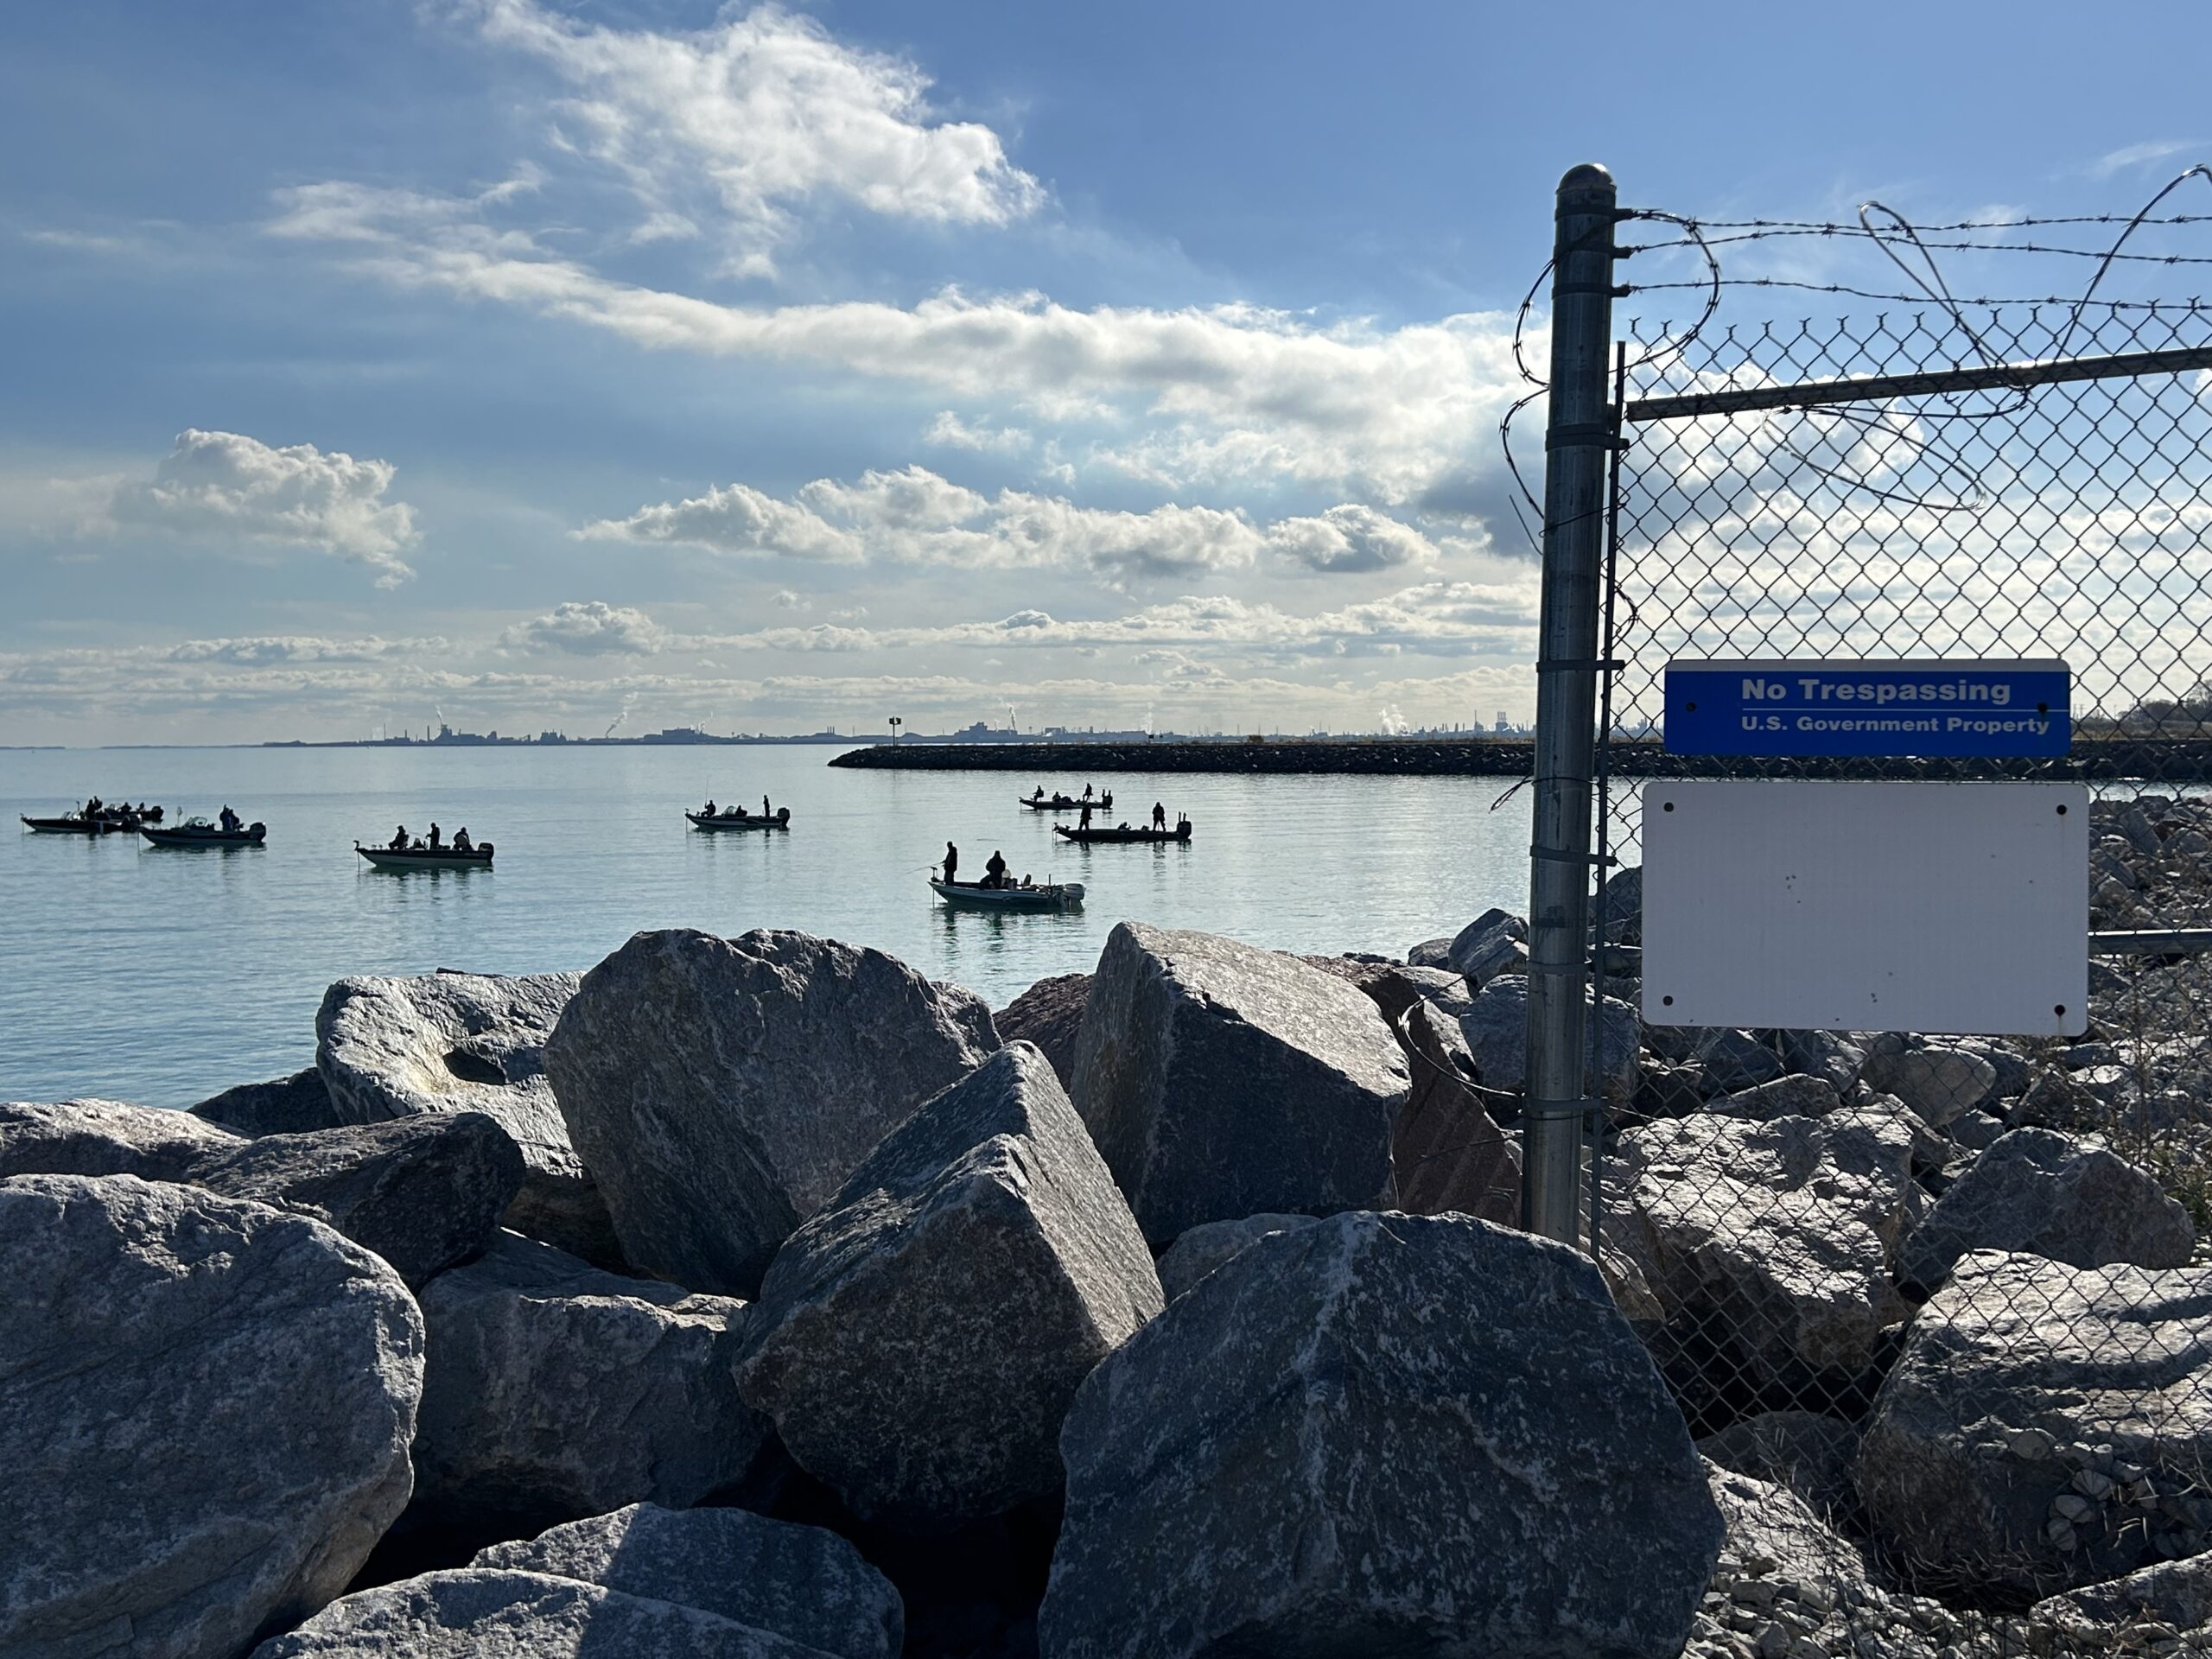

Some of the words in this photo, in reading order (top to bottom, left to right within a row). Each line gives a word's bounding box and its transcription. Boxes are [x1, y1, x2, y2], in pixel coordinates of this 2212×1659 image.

[1742, 679, 1786, 700] No
[1798, 679, 2010, 705] Trespassing
[1742, 715, 1787, 731] U.S.
[1796, 716, 1938, 731] Government
[1948, 717, 2050, 734] Property
